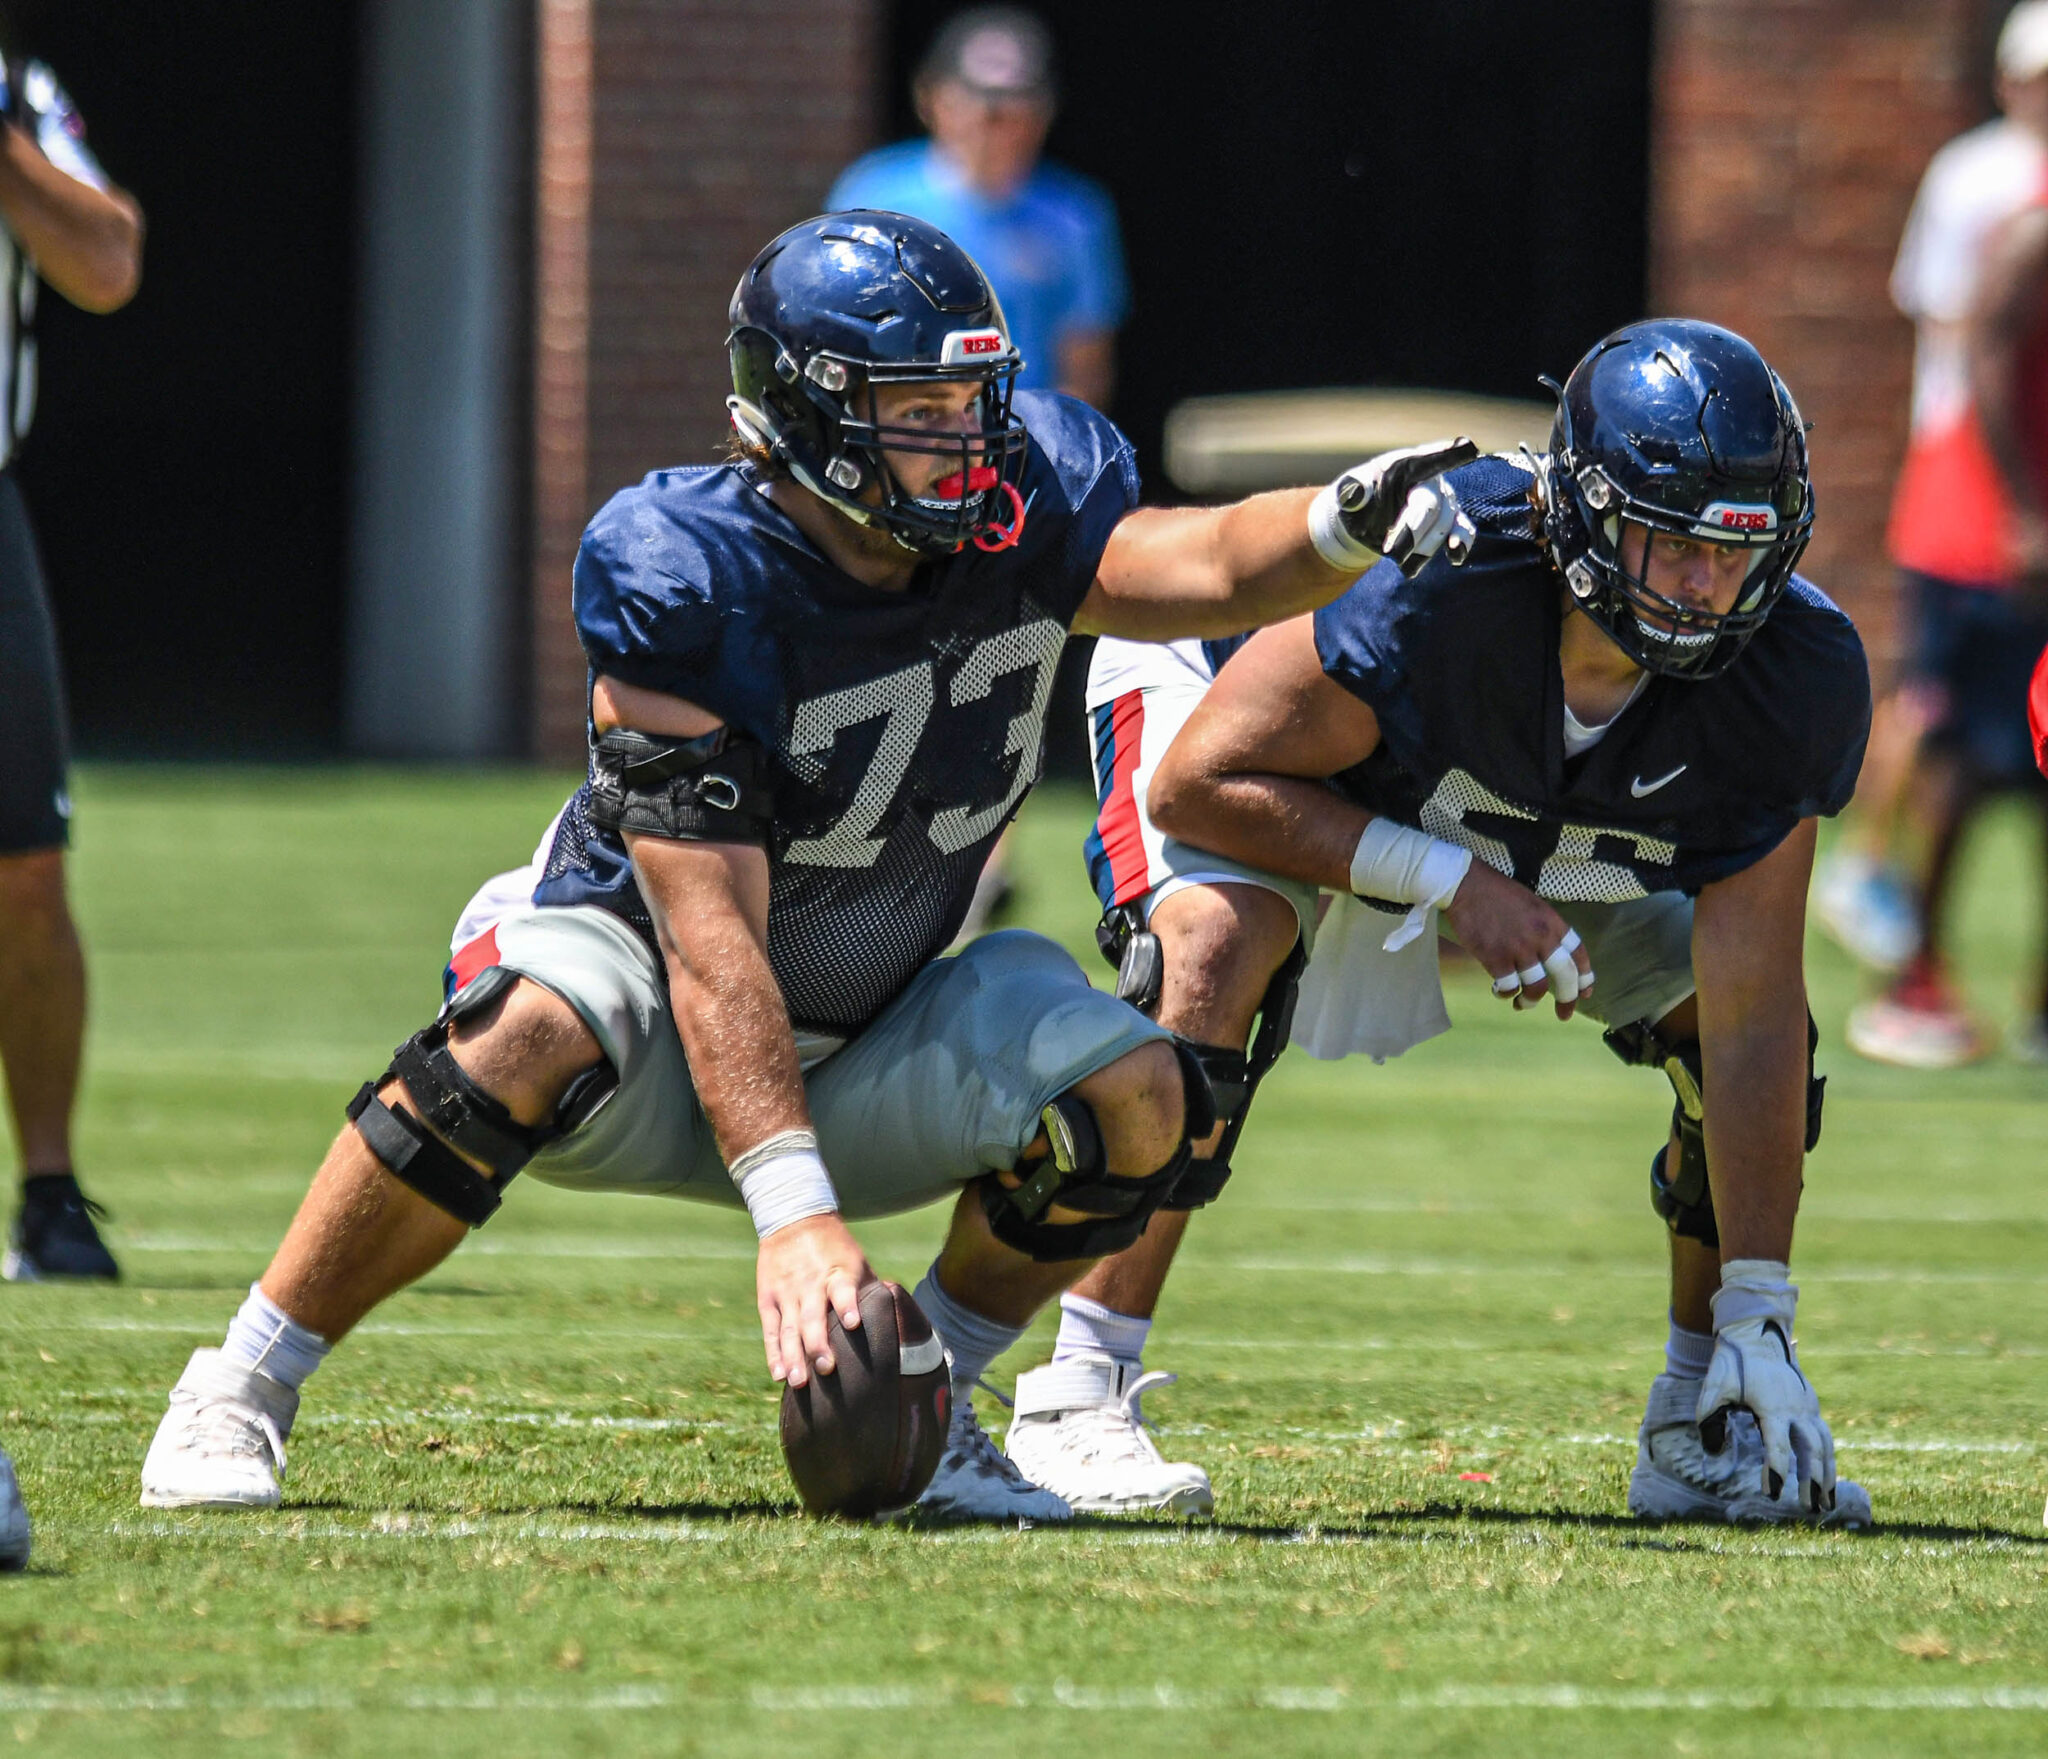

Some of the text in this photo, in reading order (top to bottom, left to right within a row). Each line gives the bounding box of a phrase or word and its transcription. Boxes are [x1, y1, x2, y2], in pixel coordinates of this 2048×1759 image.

[962, 335, 1001, 355] REBS
[1721, 509, 1768, 530] REBS
[783, 618, 1067, 868] 73
